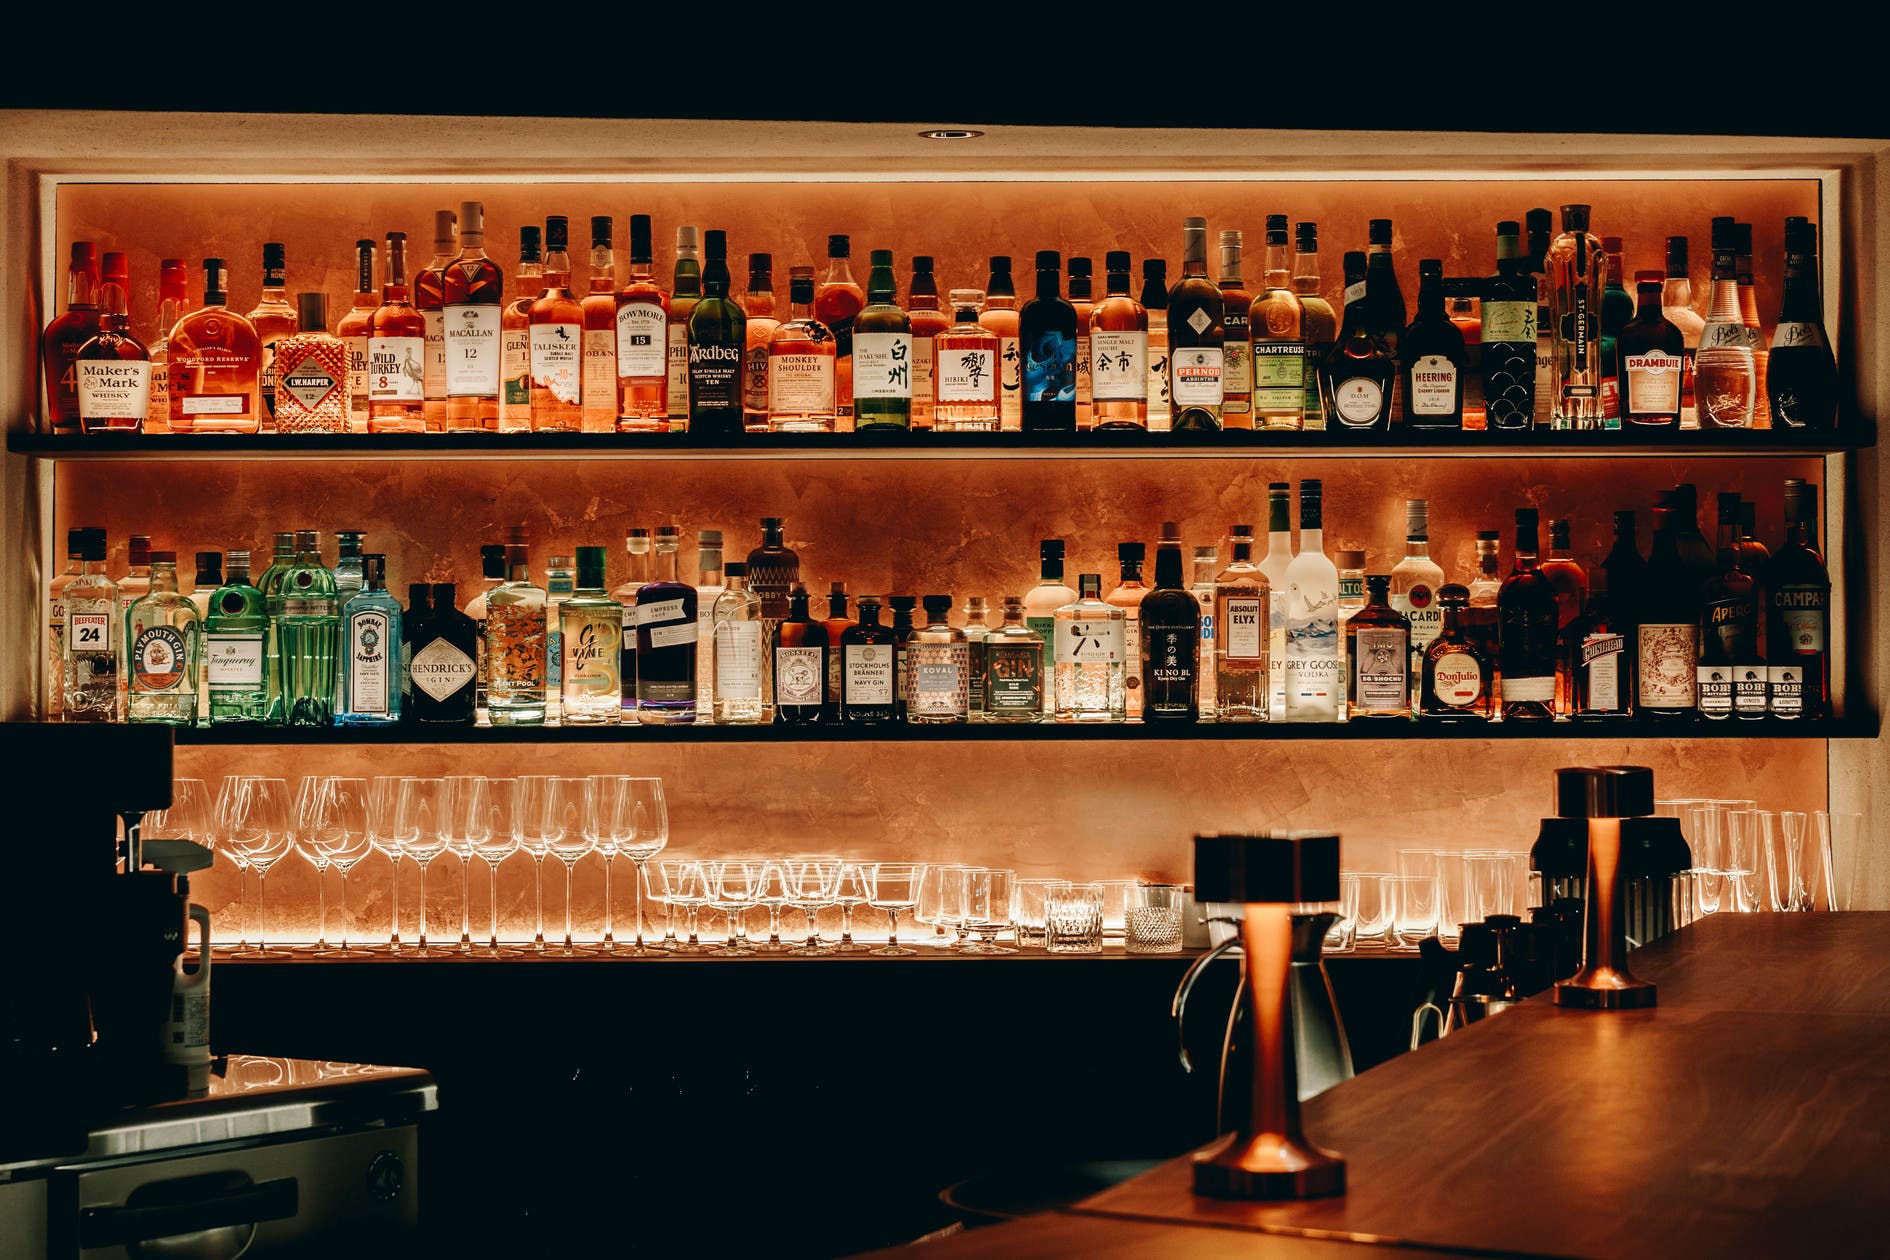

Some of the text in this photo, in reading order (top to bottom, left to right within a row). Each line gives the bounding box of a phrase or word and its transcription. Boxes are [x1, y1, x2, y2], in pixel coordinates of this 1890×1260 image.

[618, 309, 665, 324] BOWMORE
[1711, 324, 1738, 347] Bols
[1784, 324, 1812, 347] Bols
[464, 348, 477, 359] 12
[689, 344, 739, 364] Ardbeg
[1255, 346, 1304, 354] CHARTREUSE
[373, 353, 396, 364] WILD
[781, 356, 819, 364] MONKEY
[888, 338, 908, 389] 白州
[1096, 351, 1133, 372] 余市
[1629, 359, 1679, 368] DRAMBUIE
[84, 366, 140, 376] Maker's
[370, 362, 401, 375] TURKEY
[747, 363, 768, 371] HIV
[1178, 368, 1220, 376] PERNOD
[560, 369, 569, 380] 10
[1415, 372, 1452, 382] HEERING
[99, 378, 139, 388] Mark
[379, 376, 388, 388] 8
[1775, 591, 1824, 608] CAMPA
[650, 605, 679, 614] EMPRESS
[1230, 605, 1258, 613] ABSOLUT
[1711, 604, 1751, 623] APERO
[74, 617, 105, 625] BEEFEATER
[357, 618, 383, 630] BOMBAY
[1233, 615, 1255, 624] ELYX
[79, 628, 100, 642] 24
[135, 630, 184, 661] PLYMOUTH GIN
[1582, 638, 1624, 662] COINTREAU
[210, 654, 256, 667] Tanqueray
[356, 651, 383, 663] SAPPHIRE
[412, 664, 472, 673] HENDRICK'S
[1287, 661, 1306, 670] GREY
[878, 688, 889, 696] 57
